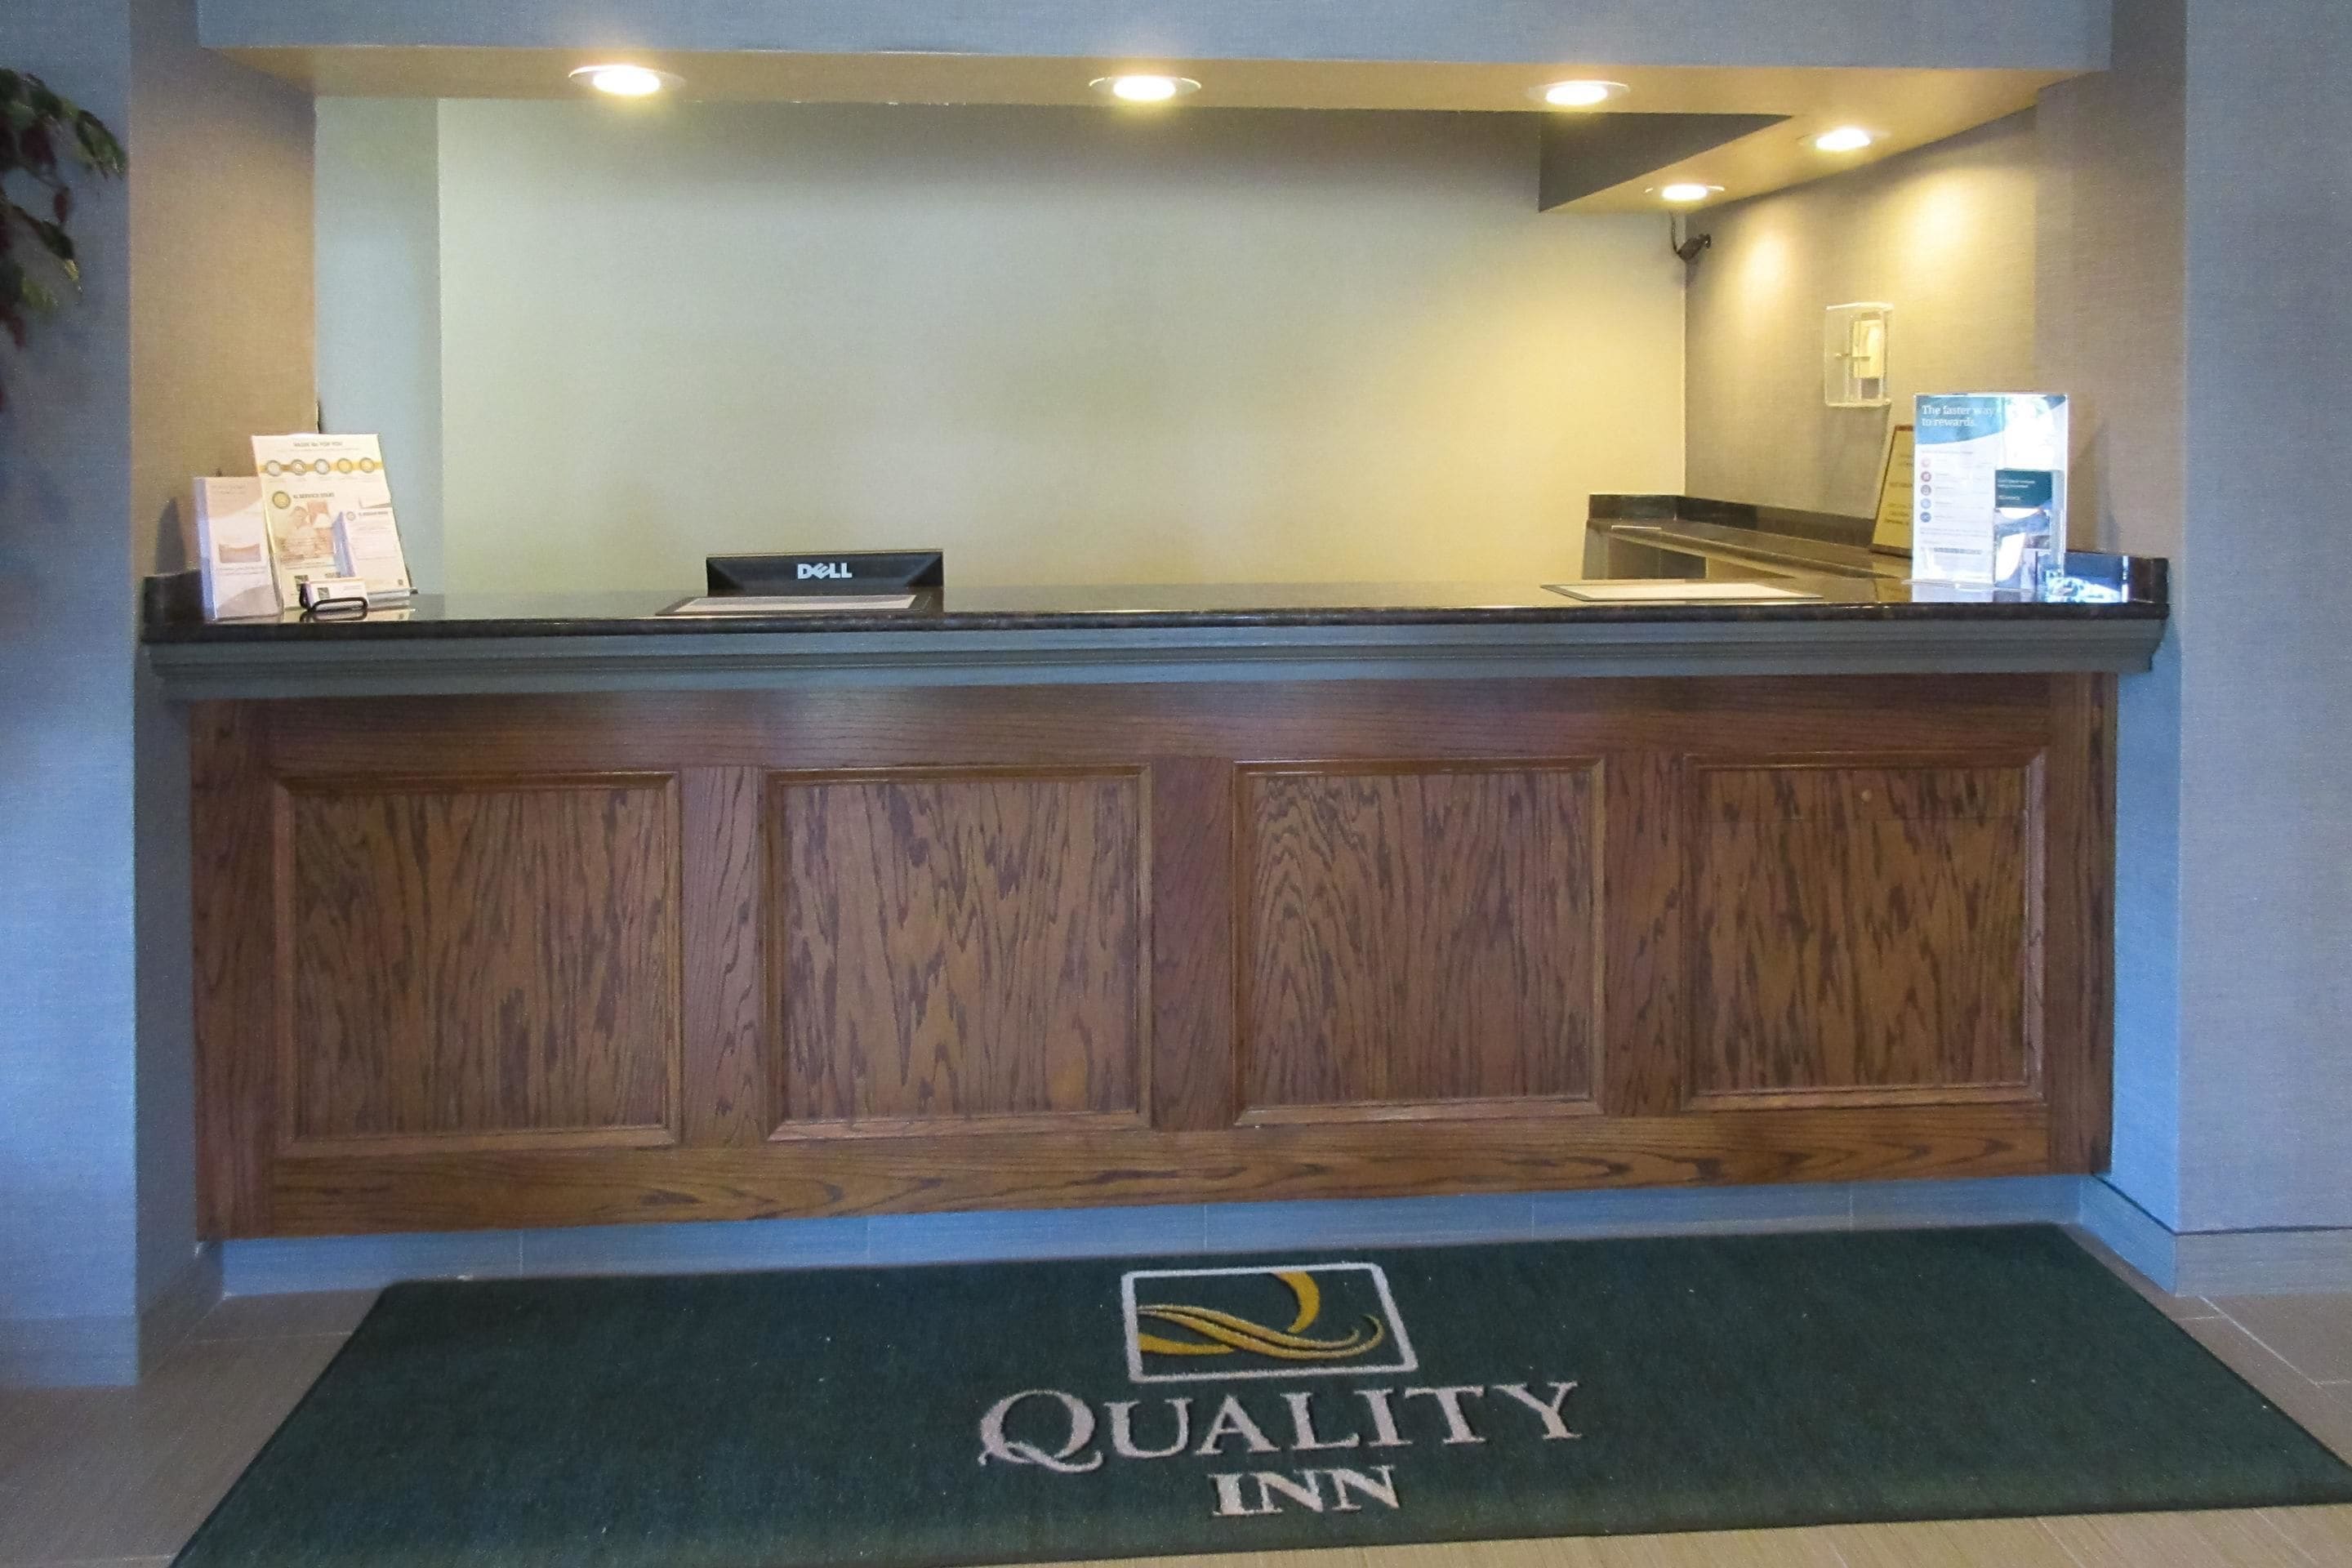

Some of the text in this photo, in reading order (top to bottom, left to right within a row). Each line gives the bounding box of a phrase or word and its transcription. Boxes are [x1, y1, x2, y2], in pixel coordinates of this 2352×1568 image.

[1922, 405, 1993, 417] The faster way
[1922, 418, 1931, 426] to
[798, 562, 853, 579] DELL
[978, 1382, 1581, 1473] QUALITY
[1209, 1465, 1401, 1517] INN
